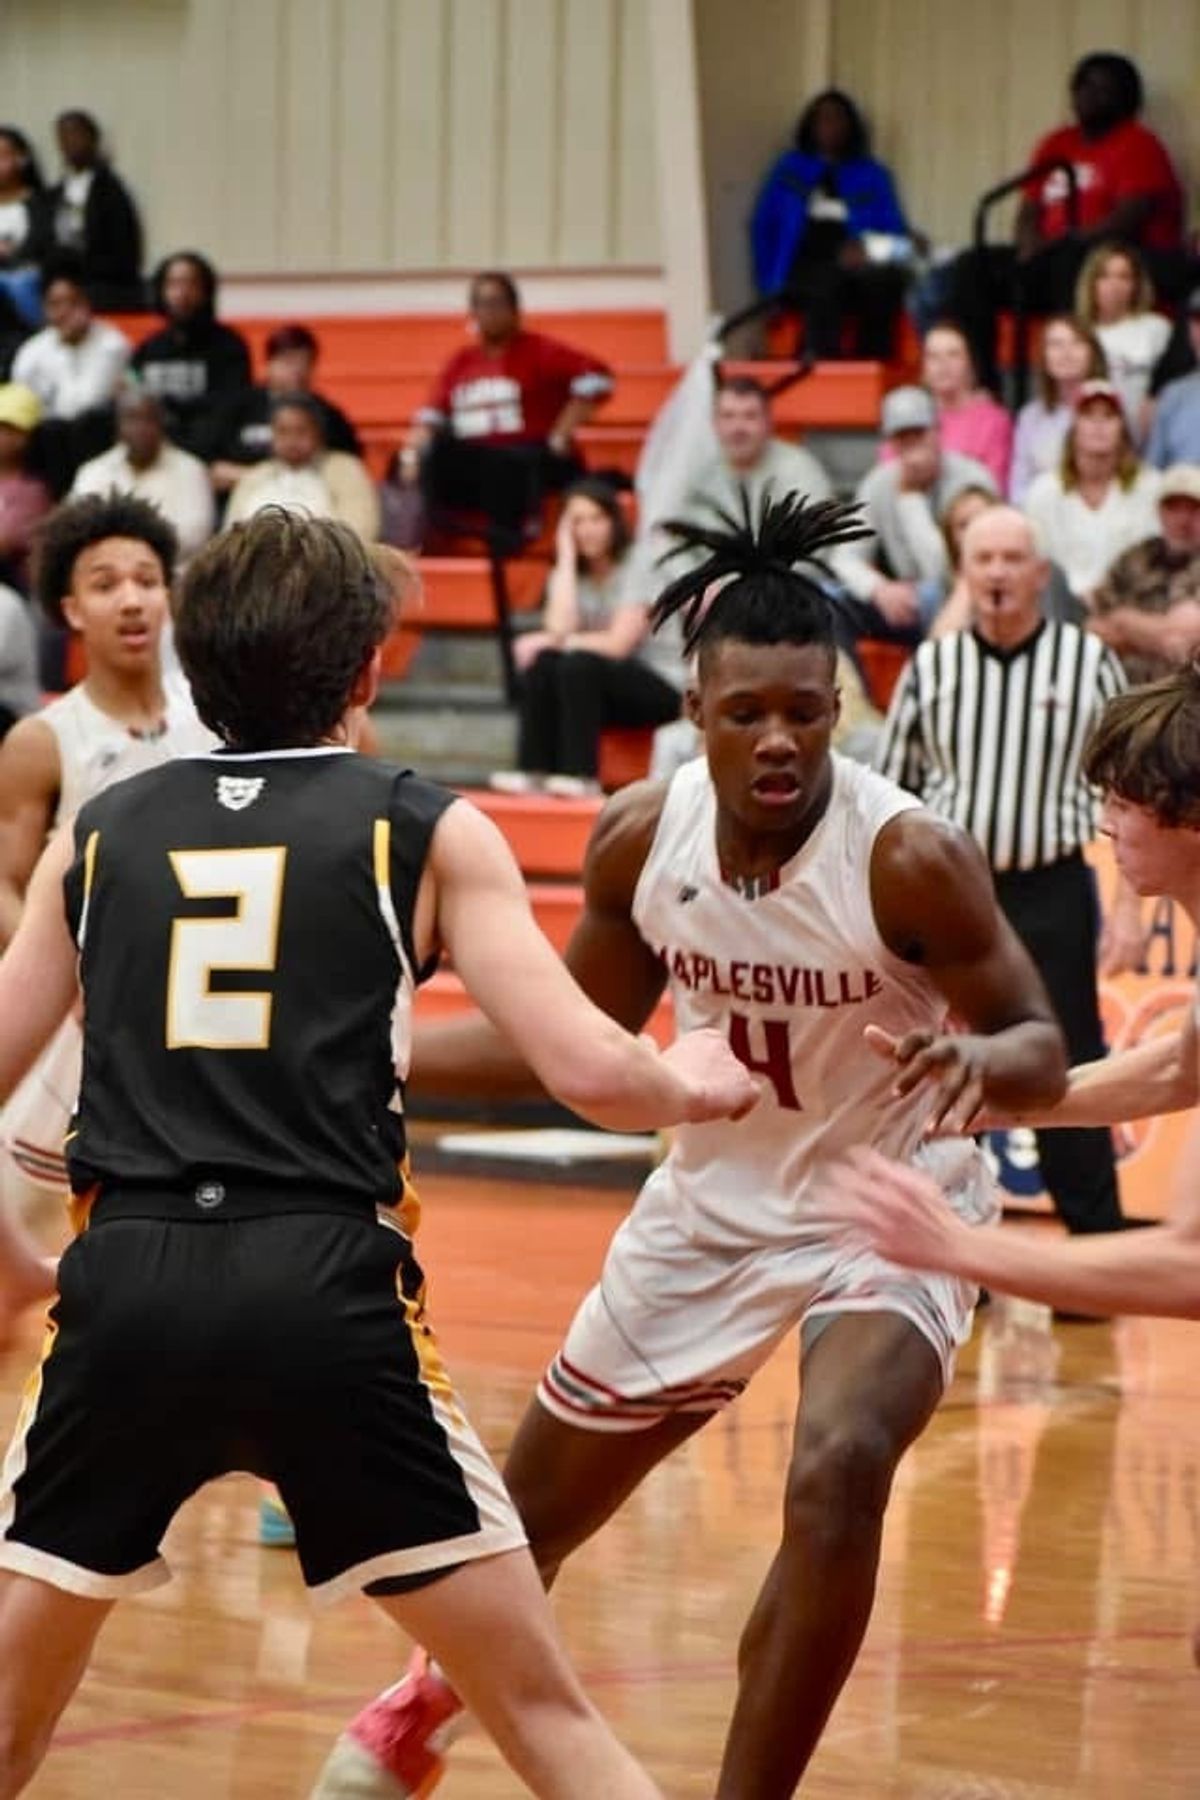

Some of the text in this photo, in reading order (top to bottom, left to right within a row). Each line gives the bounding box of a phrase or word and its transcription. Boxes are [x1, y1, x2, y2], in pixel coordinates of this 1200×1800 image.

[166, 846, 287, 1050] 2
[659, 945, 884, 1008] APLESVILLE
[729, 1008, 803, 1112] 4
